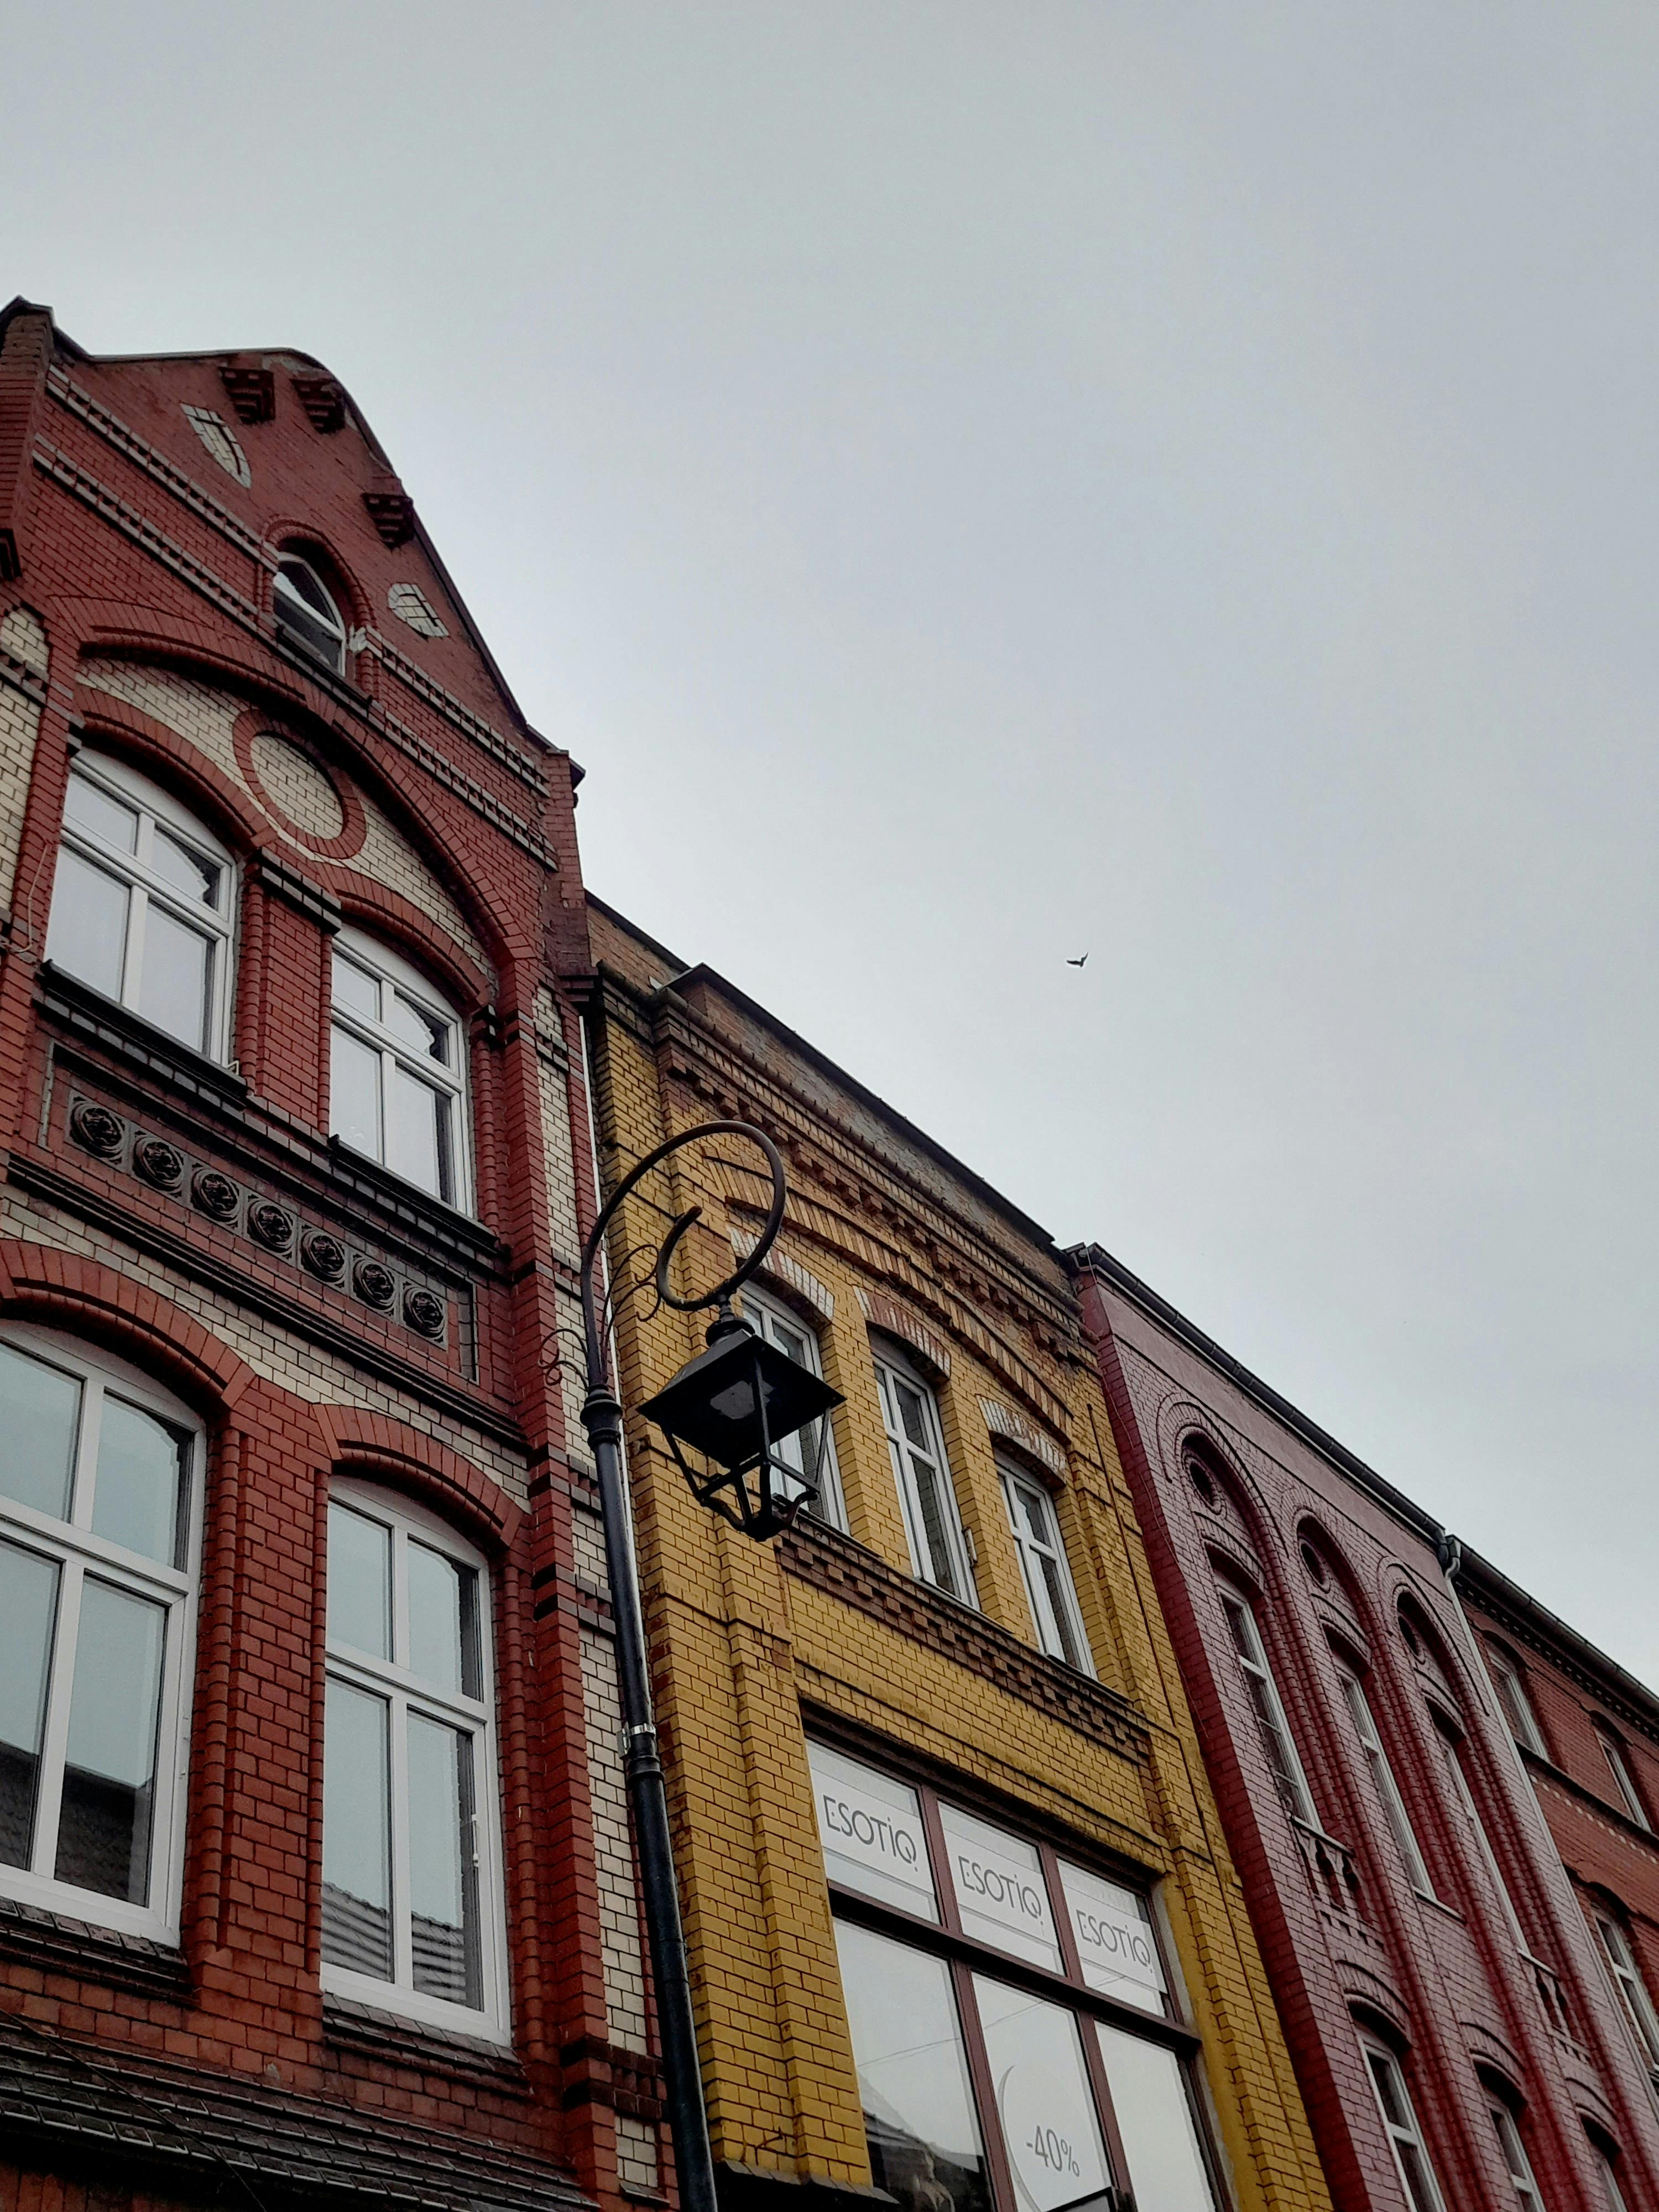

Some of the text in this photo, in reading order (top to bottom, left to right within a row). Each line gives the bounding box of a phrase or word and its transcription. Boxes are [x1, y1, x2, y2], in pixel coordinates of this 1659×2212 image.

[823, 1794, 918, 1872] ESOTIQ
[958, 1855, 1044, 1926] ESOTIQ
[1076, 1909, 1153, 1973] ESOTIQ
[1026, 2125, 1079, 2178] -40%
